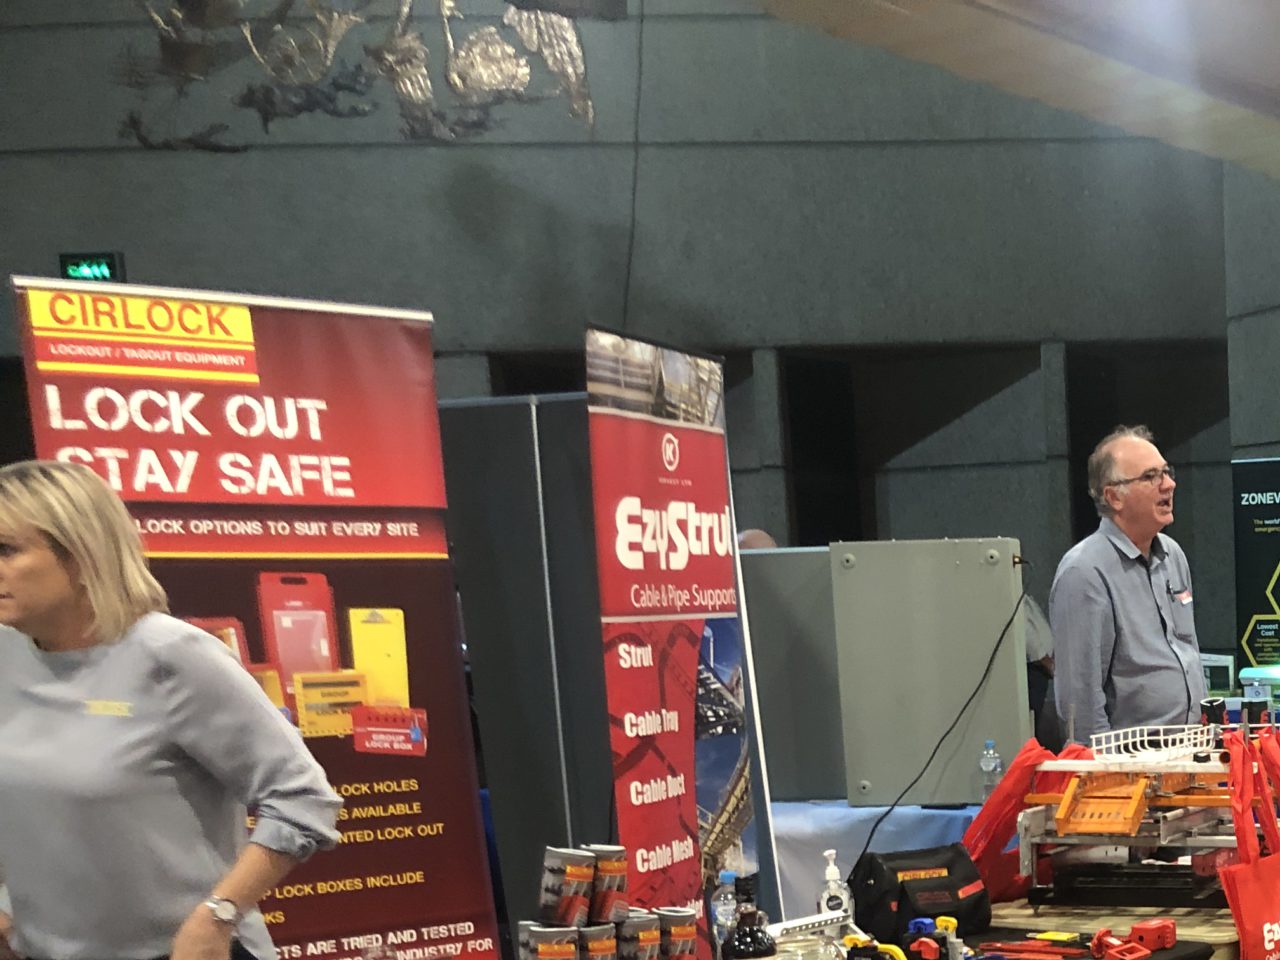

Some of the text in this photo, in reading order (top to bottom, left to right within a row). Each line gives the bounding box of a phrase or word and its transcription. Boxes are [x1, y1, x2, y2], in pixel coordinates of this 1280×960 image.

[48, 291, 234, 337] CIRLOCK
[49, 343, 111, 359] LOCKOUT
[123, 348, 172, 362] TAGOUT
[175, 351, 246, 366] EQUIPMENT
[44, 384, 327, 441] LOCK OUT
[218, 451, 355, 498] SAFE
[137, 518, 420, 538] LOCK OPTIONS TO SUIT EVERY SITE
[631, 584, 661, 608] Cable
[668, 584, 691, 612] Pipe
[618, 642, 654, 670] Strut
[624, 708, 680, 738] Cable Tray
[373, 779, 420, 794] HOLES
[630, 777, 667, 806] Cable
[351, 802, 422, 819] AVAILABLE
[337, 823, 445, 844] NTED LOCK OUT
[635, 844, 672, 873] Cable
[275, 884, 314, 899] LOCK
[316, 879, 364, 894] BOXES
[366, 871, 425, 888] INCLUDE
[306, 940, 338, 956] ARE
[340, 934, 383, 951] TRIED
[386, 929, 417, 944] AND
[421, 922, 475, 941] TESTED
[467, 937, 493, 953] FOR
